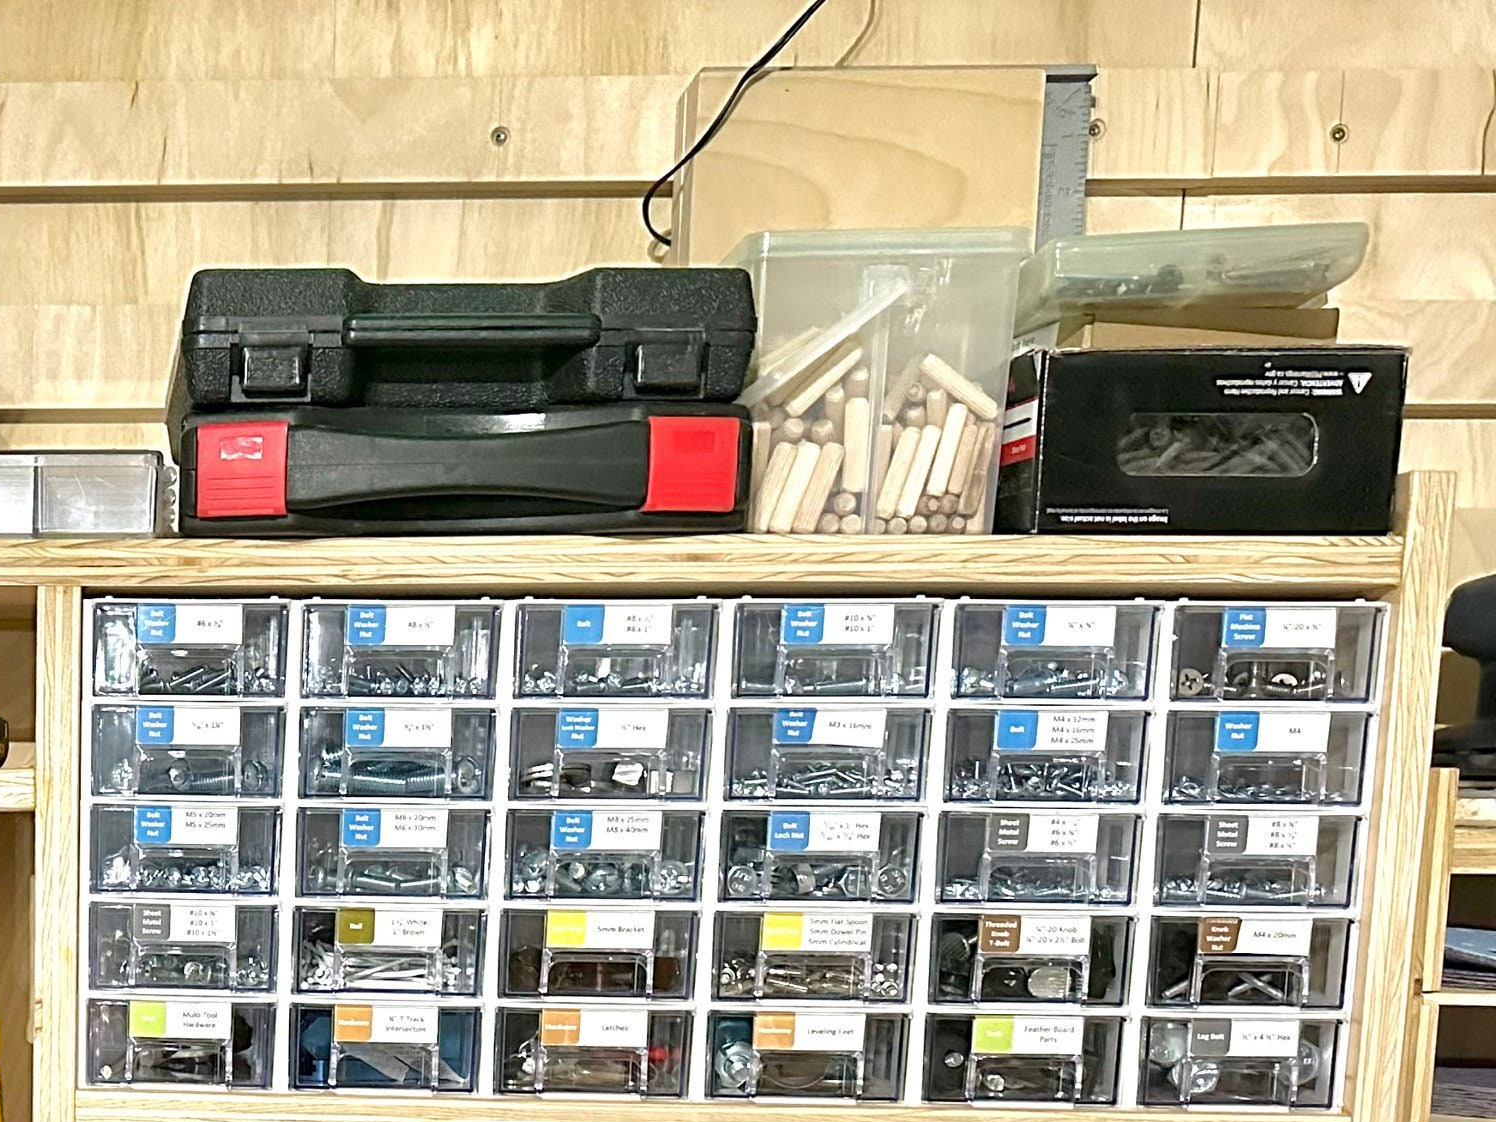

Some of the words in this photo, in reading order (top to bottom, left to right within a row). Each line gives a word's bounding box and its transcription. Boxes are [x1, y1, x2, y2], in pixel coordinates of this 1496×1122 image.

[847, 919, 868, 927] Spoon
[985, 921, 1017, 929] Threaded
[829, 938, 866, 947] Cylindrical
[807, 1028, 836, 1036] Leveling
